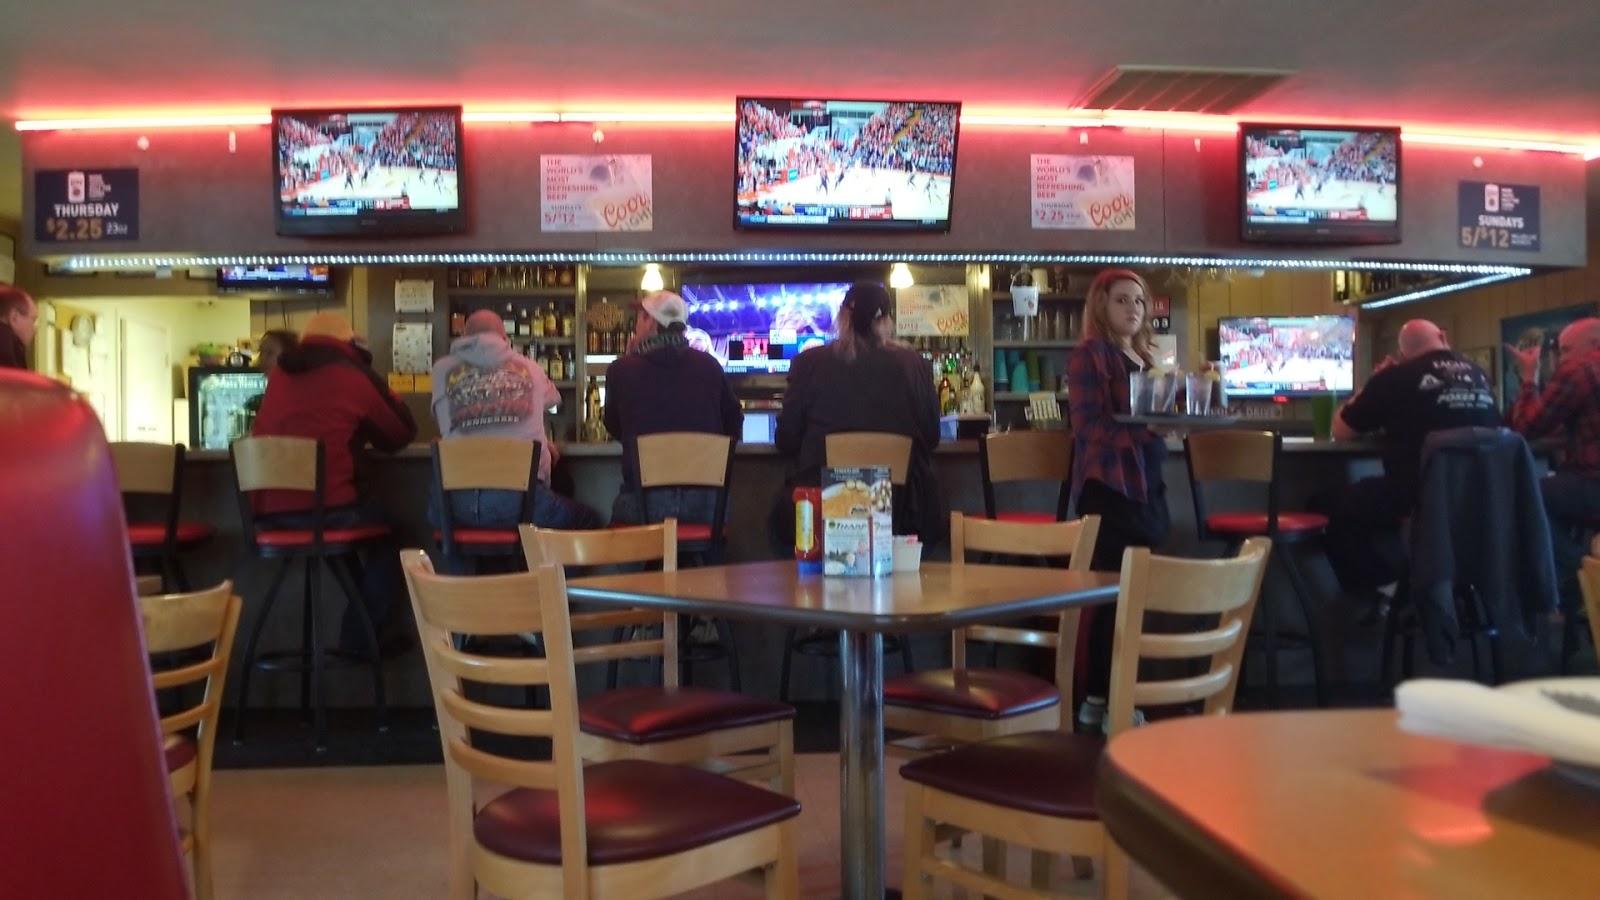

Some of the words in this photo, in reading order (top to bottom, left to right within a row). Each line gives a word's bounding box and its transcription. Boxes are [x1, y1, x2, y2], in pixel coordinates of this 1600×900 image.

[53, 202, 120, 218] THURSDAY
[46, 217, 103, 240] $2.25
[1478, 214, 1525, 229] SUNDAYS
[1461, 226, 1510, 248] 5/$12
[461, 415, 521, 429] TENNESSEE
